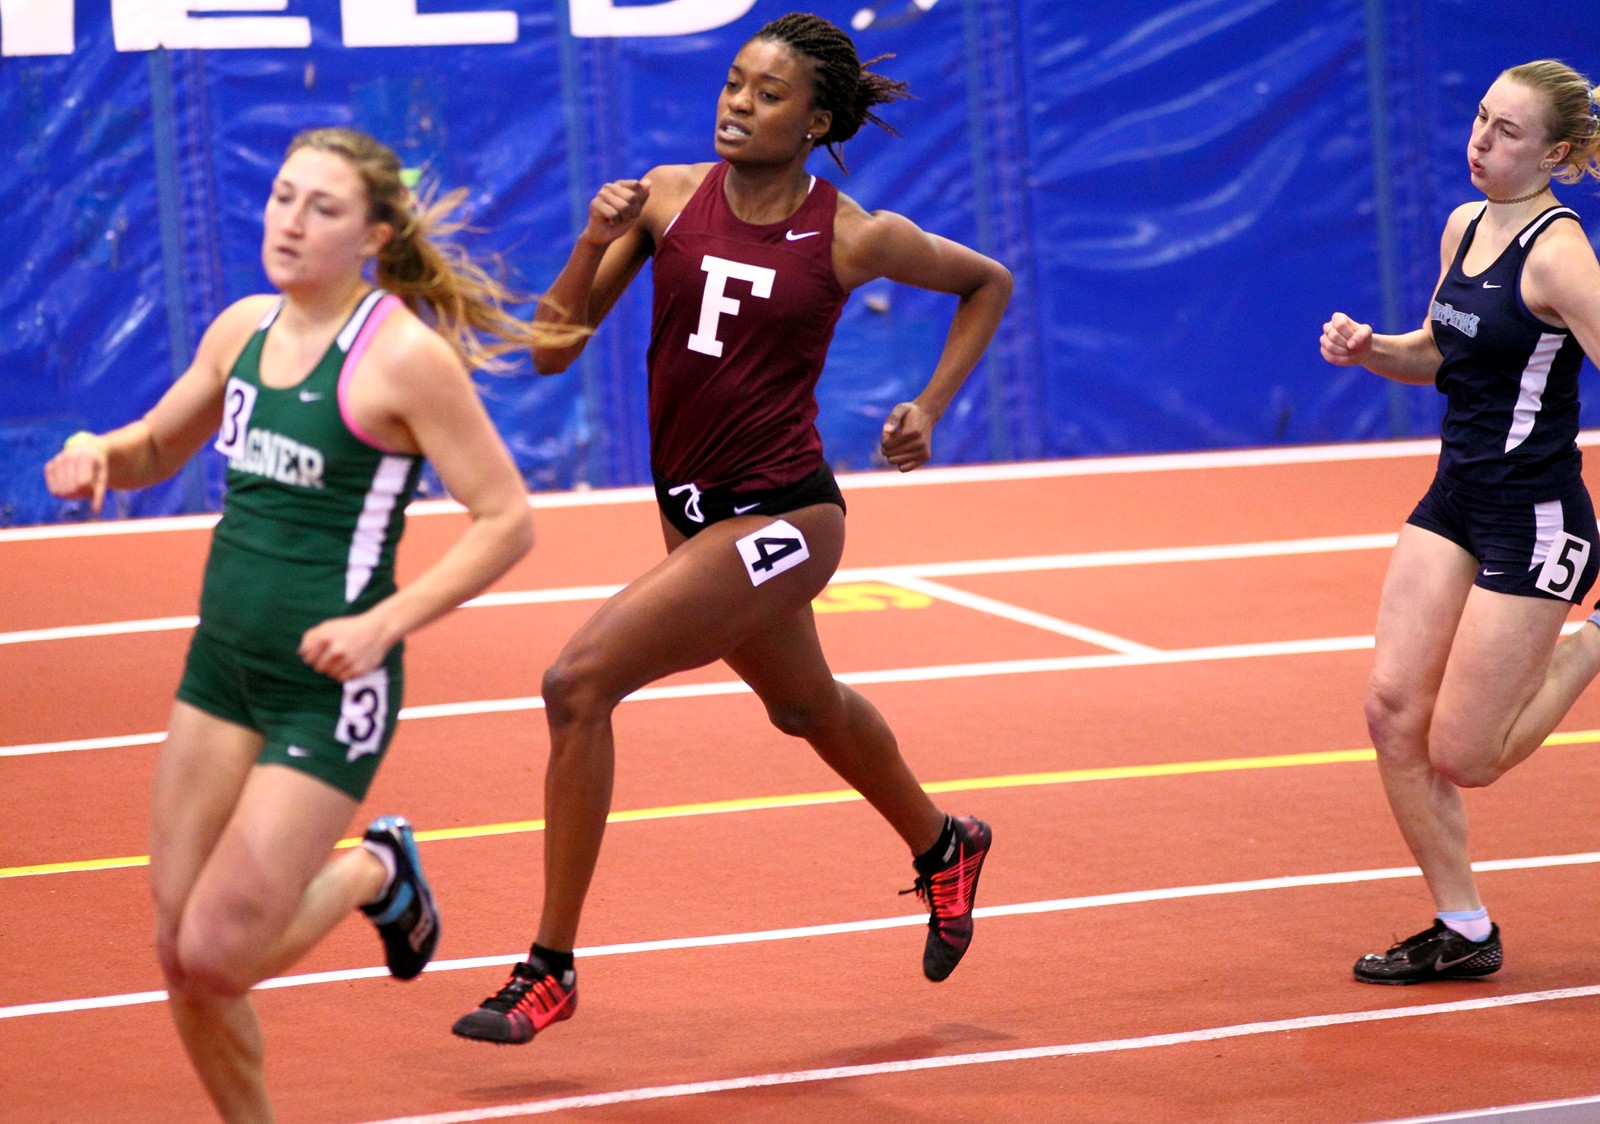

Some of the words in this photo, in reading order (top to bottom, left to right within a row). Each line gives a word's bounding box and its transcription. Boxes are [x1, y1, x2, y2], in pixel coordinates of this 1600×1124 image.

[687, 254, 777, 358] F
[223, 388, 246, 447] 3
[228, 427, 326, 490] GNER
[751, 537, 803, 574] 4
[1547, 538, 1584, 593] 5
[347, 687, 379, 743] 3
